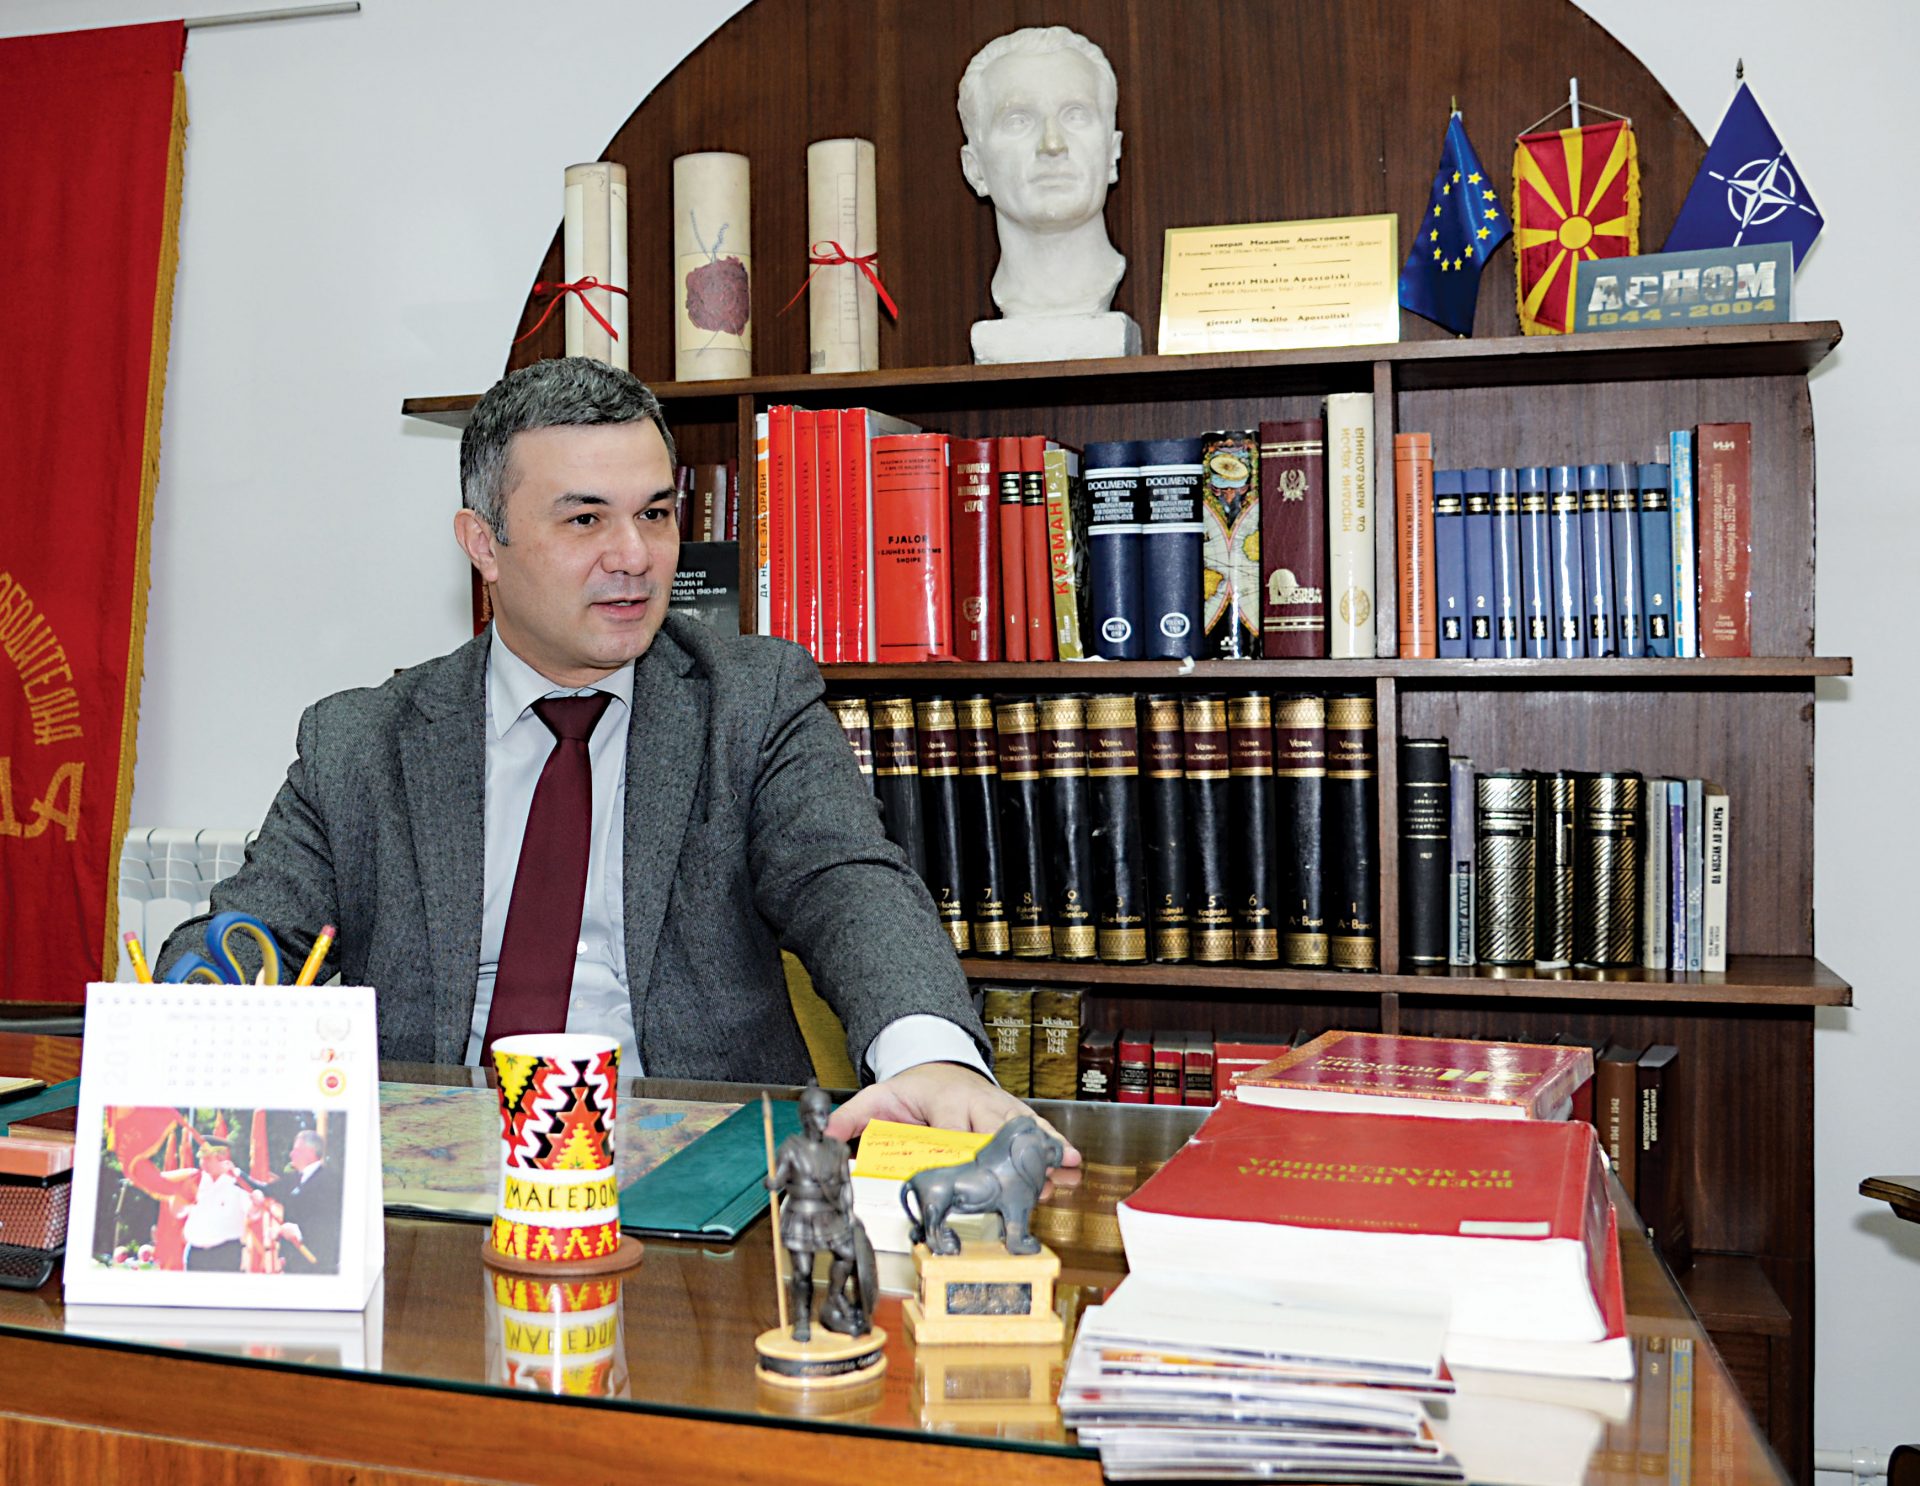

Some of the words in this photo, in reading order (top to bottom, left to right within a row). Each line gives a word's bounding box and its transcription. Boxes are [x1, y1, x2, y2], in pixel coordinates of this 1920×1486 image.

[1208, 280, 1246, 288] general
[1294, 273, 1350, 283] Apostolski
[1587, 260, 1777, 312] АСНОМ
[1587, 309, 1661, 326] 1944
[1689, 299, 1776, 318] 2004
[1354, 428, 1365, 508] македонија
[1088, 480, 1138, 490] DOCUMENTS
[1146, 476, 1198, 486] DOCUMENTS
[760, 473, 768, 536] ЗАБОРАВИ
[1356, 516, 1366, 532] од
[888, 536, 928, 544] FJALOR
[760, 544, 768, 556] СЕ
[1048, 502, 1070, 596] КУЗМАН
[760, 563, 768, 577] НЕ
[760, 584, 768, 598] ДА
[1448, 596, 1454, 608] 1
[942, 888, 950, 900] 7
[984, 888, 992, 899] 7
[1024, 892, 1032, 904] 8
[1068, 890, 1077, 903] 9
[1117, 896, 1124, 908] 3
[1166, 894, 1172, 906] 5
[1208, 896, 1216, 907] 5
[1249, 894, 1258, 906] 6
[1289, 916, 1296, 926] A
[1338, 920, 1345, 929] A
[993, 1016, 1024, 1026] leksikon
[1042, 1016, 1073, 1026] leksikon
[997, 1028, 1019, 1036] NOR
[1046, 1028, 1068, 1037] NOR
[1250, 1158, 1457, 1178] МАКЕДОНИЈА
